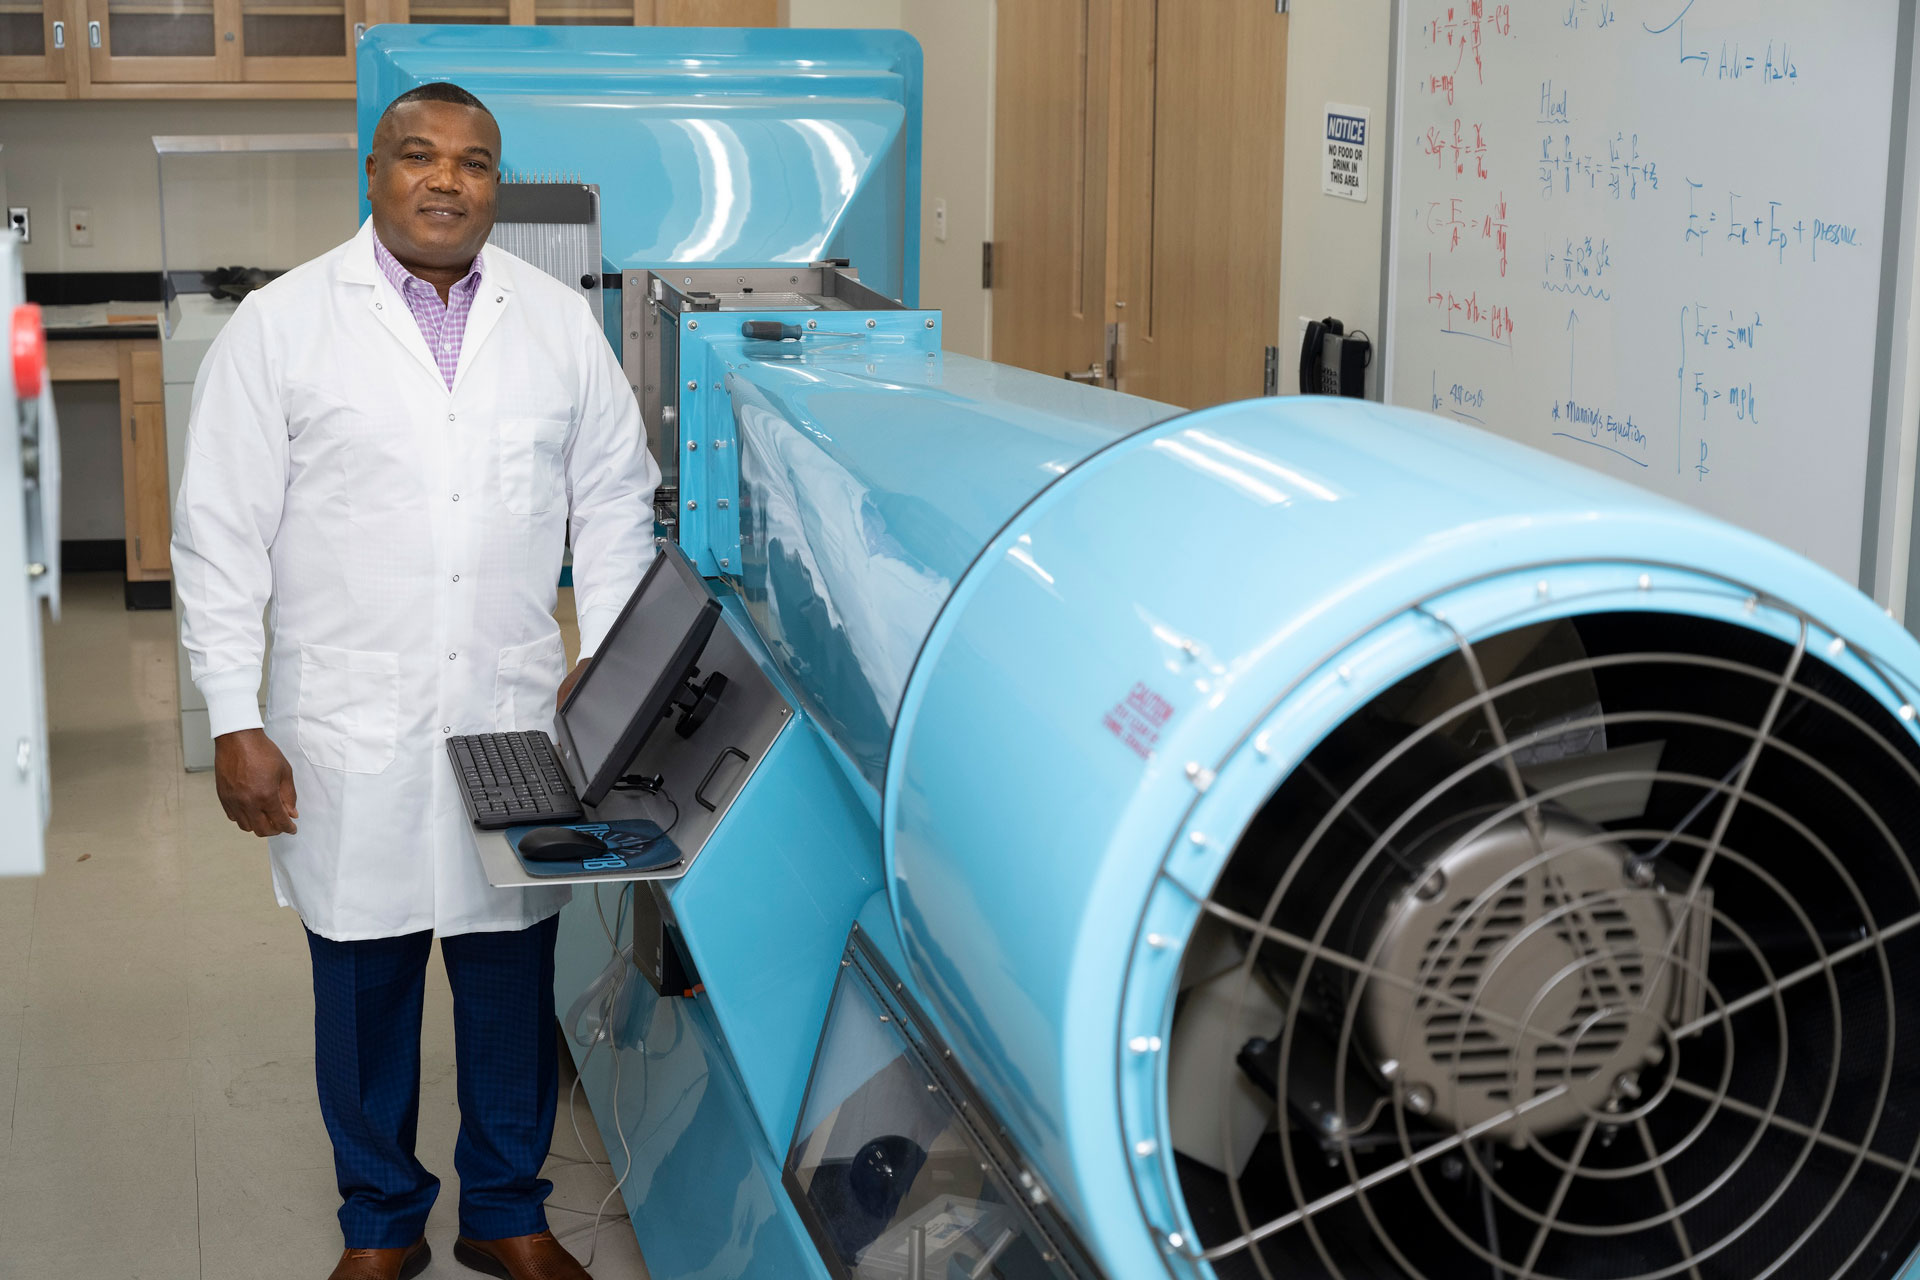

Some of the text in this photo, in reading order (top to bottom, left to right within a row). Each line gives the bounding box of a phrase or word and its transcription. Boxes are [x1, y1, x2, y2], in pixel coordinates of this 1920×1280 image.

[1540, 79, 1567, 118] Head
[1327, 116, 1365, 142] NOTICE
[1328, 144, 1363, 160] NO FOOD OR
[1332, 158, 1358, 173] DRINK IN
[1330, 171, 1359, 188] THIS AREA
[1606, 414, 1647, 450] Equation
